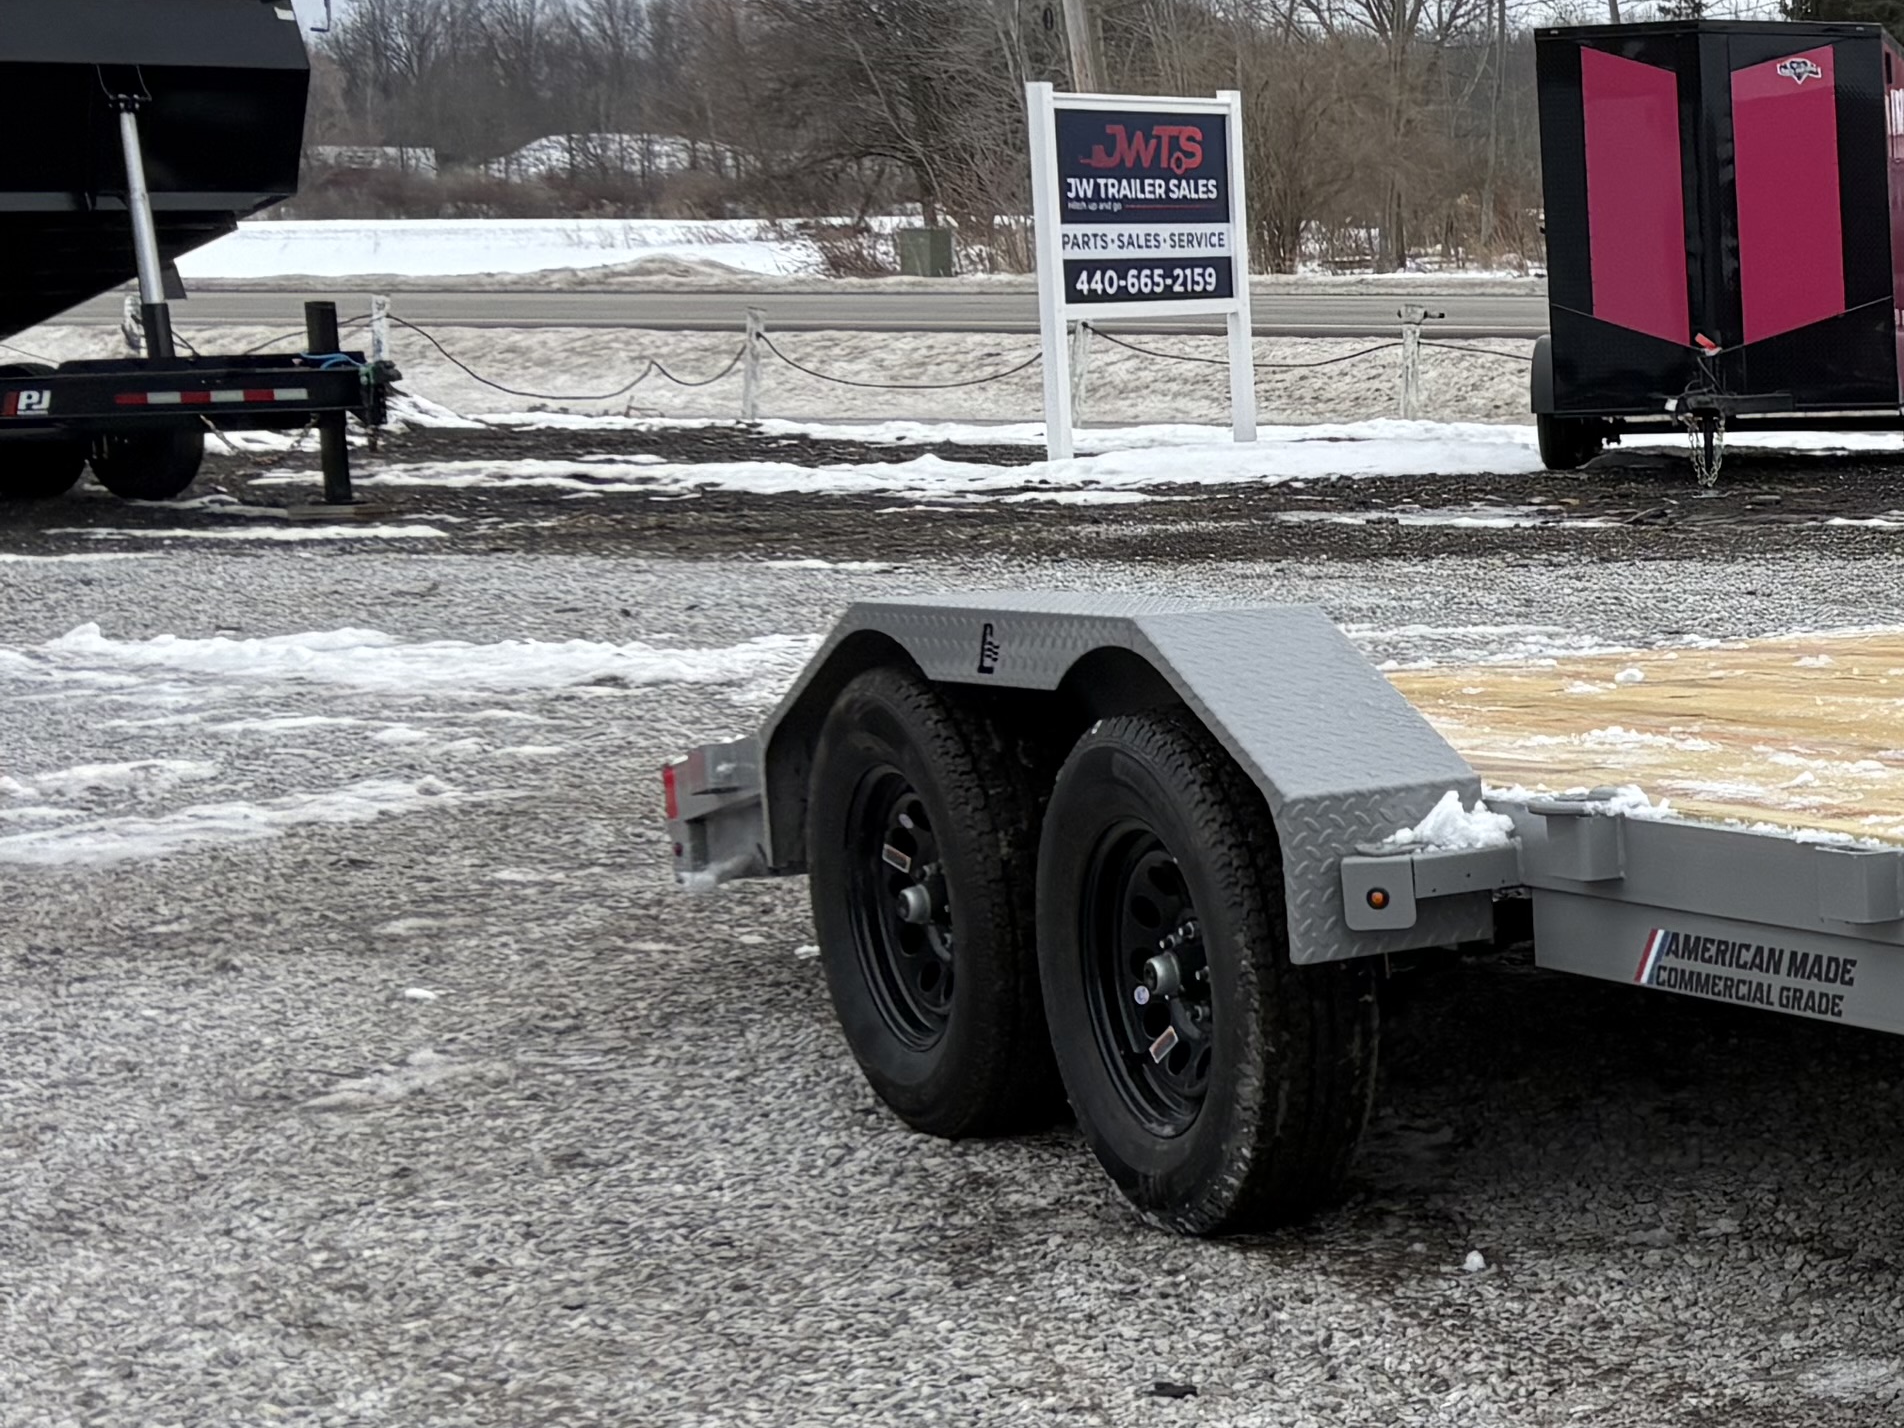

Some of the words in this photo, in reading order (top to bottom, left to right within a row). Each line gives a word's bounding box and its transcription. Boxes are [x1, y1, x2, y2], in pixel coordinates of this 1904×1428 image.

[1066, 178, 1094, 199] JW
[1096, 178, 1166, 199] TRAILER
[1168, 178, 1218, 200] SALES
[1062, 233, 1109, 250] PARTS
[1116, 233, 1161, 250] SALES
[1169, 232, 1226, 248] SERVICE
[1075, 266, 1217, 295] 440-665-2159
[17, 390, 52, 410] PJ
[1665, 932, 1784, 976] AMERICAN
[1786, 949, 1858, 987] MADE
[1656, 965, 1775, 1007] COMMERCIAL
[1778, 985, 1844, 1018] GRADE
